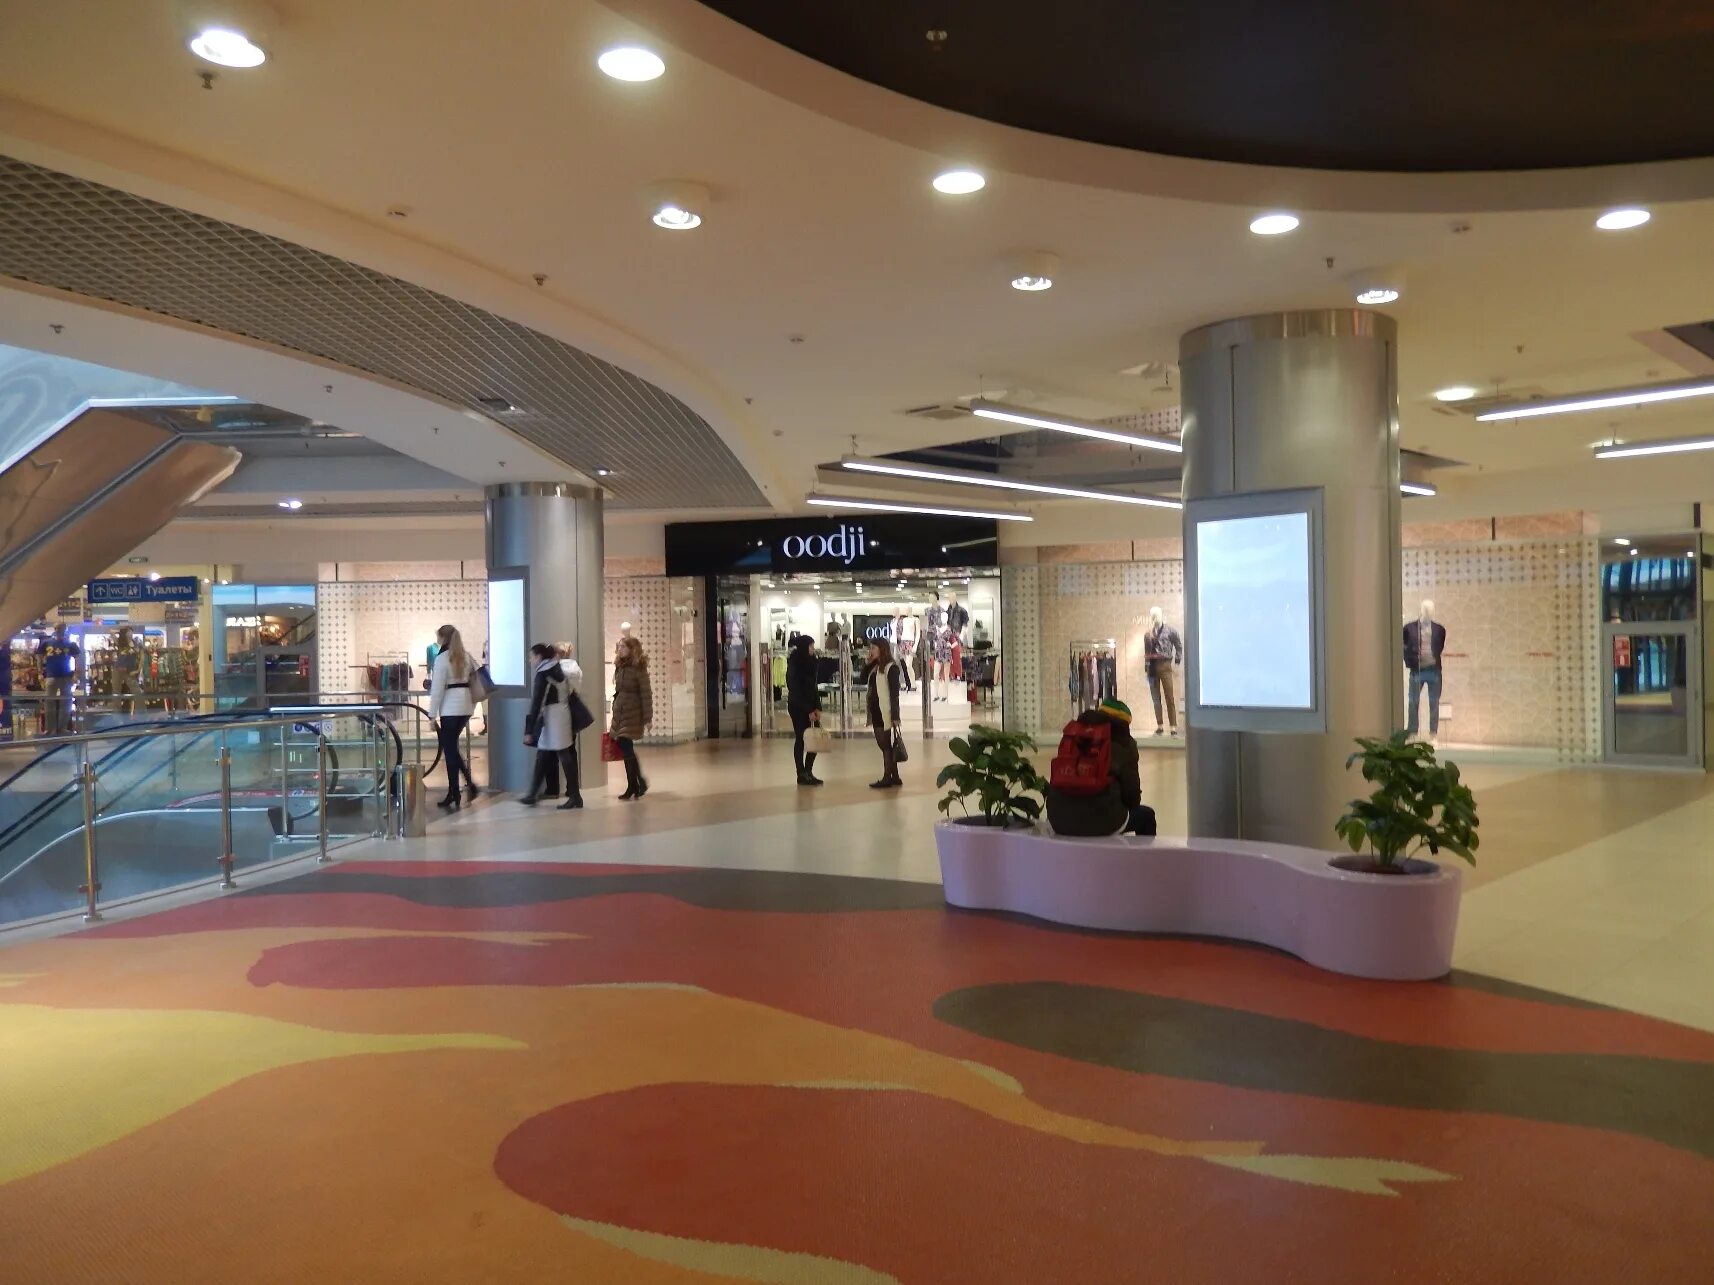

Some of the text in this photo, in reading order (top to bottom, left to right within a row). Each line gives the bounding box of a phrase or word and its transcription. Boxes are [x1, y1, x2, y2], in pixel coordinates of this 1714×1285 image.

[783, 524, 865, 565] oodji
[145, 585, 192, 596] Туалеты
[866, 622, 892, 640] ood
